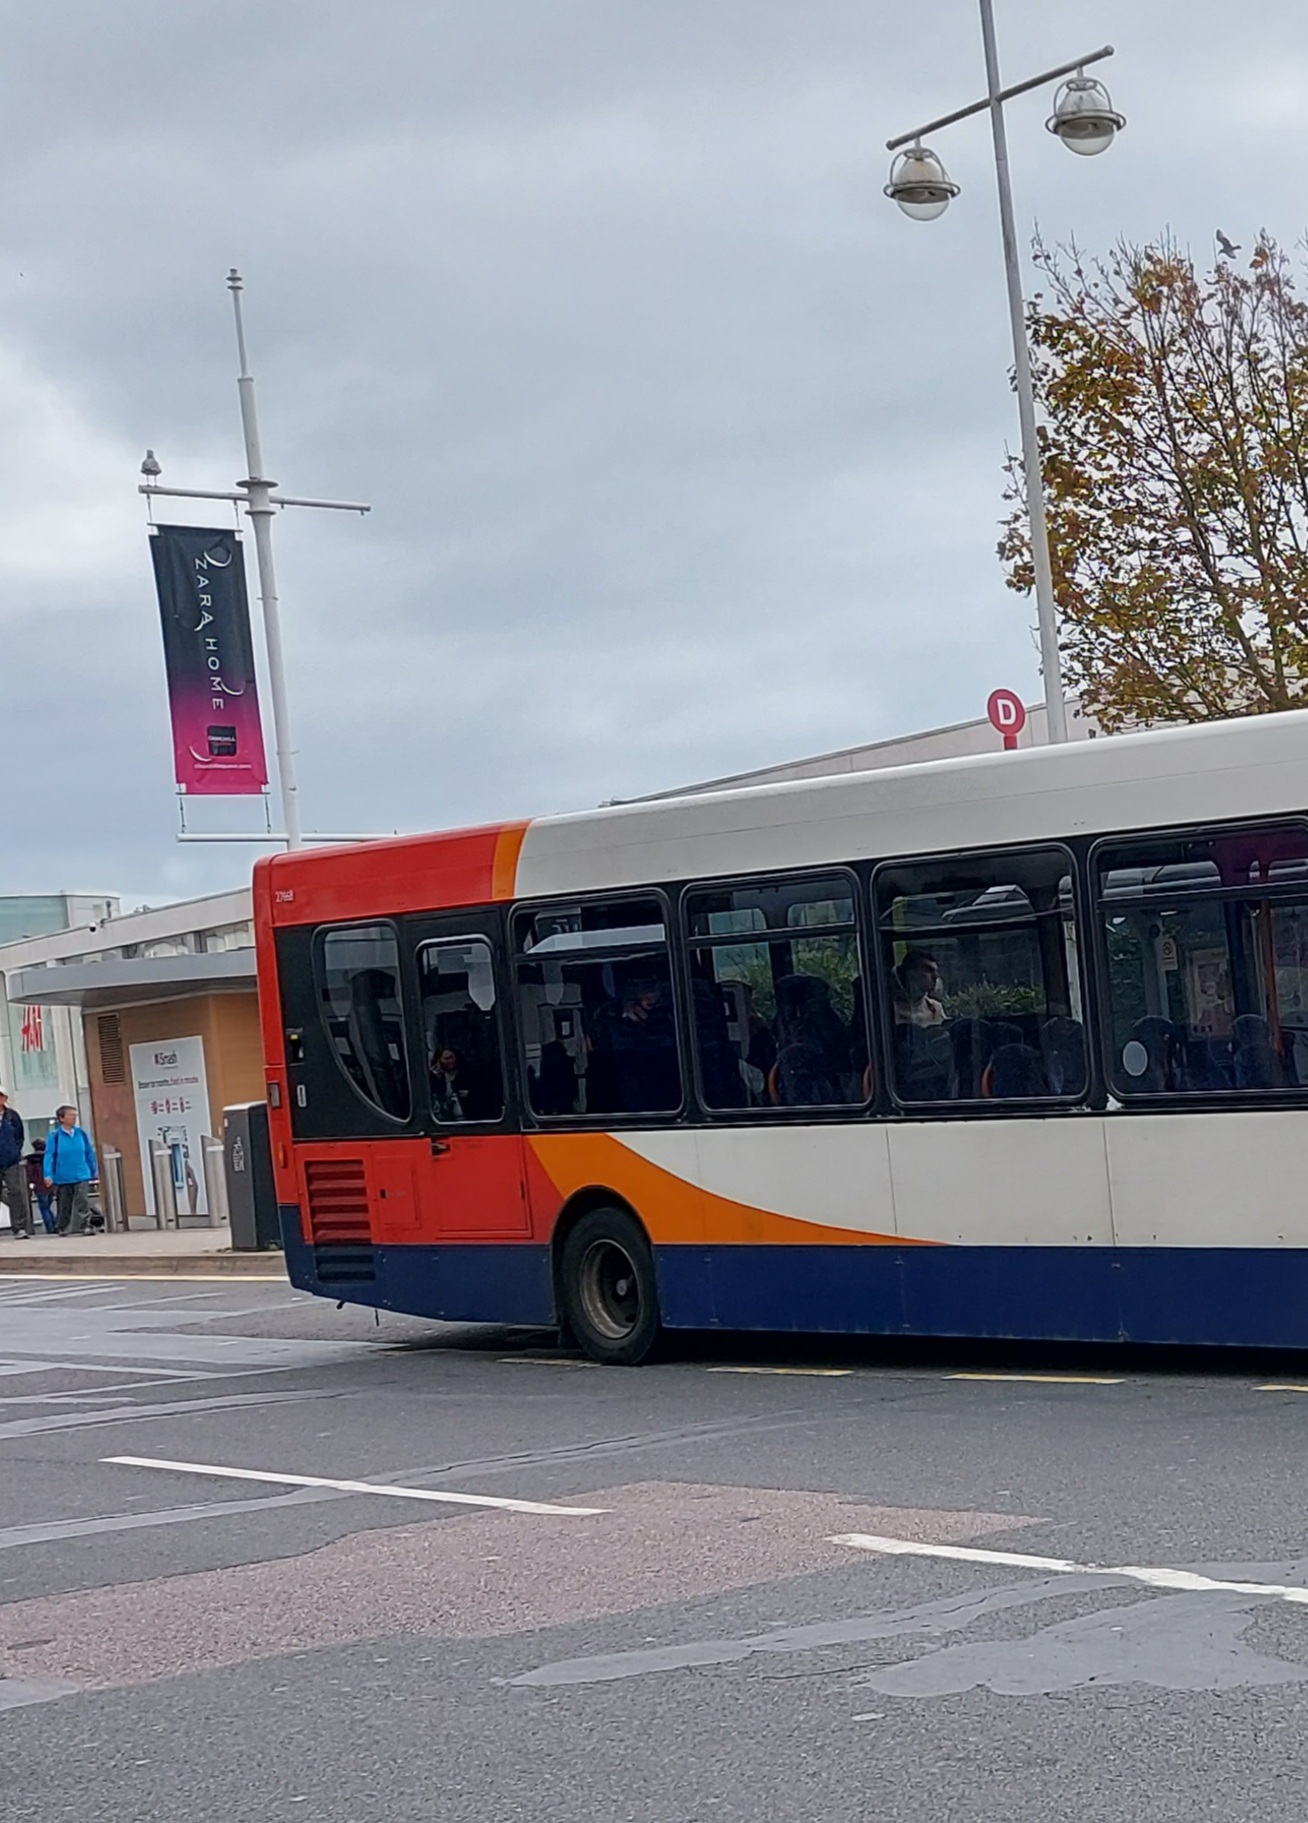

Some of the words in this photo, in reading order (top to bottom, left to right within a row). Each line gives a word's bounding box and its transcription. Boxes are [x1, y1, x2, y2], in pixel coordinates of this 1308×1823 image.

[194, 557, 214, 632] ZARA
[205, 637, 225, 710] HOME
[996, 698, 1017, 725] D
